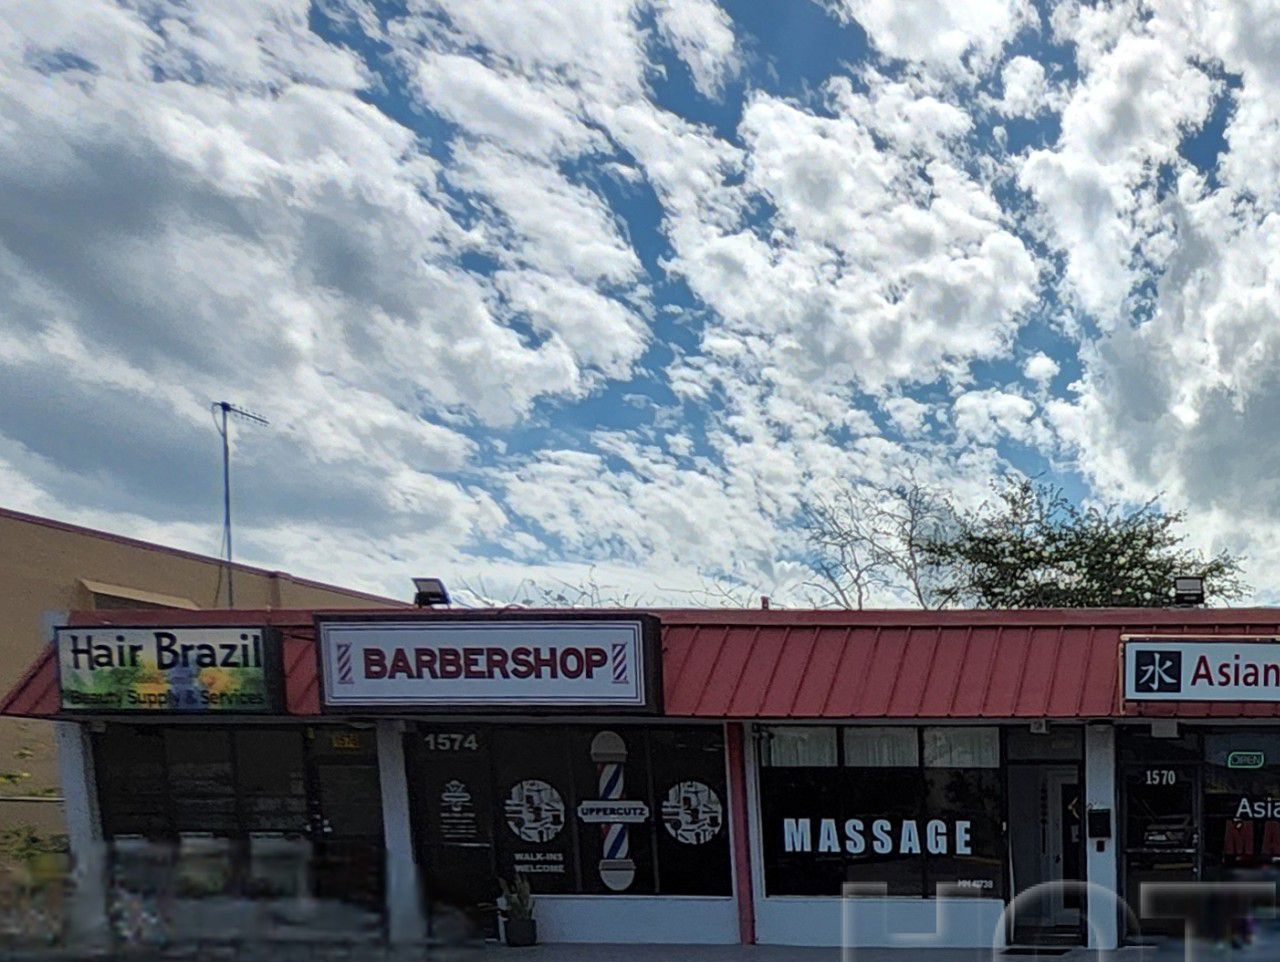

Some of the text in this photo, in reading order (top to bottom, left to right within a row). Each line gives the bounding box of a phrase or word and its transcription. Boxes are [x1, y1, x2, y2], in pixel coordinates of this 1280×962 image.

[70, 632, 263, 671] Hair Brazil
[363, 647, 608, 680] BARBERSHOP
[1138, 653, 1178, 690] 水
[1190, 654, 1280, 688] Asian
[127, 689, 180, 708] Supply
[201, 690, 265, 705] Services
[424, 733, 479, 751] 1574
[1232, 755, 1261, 765] OPEN
[1145, 771, 1176, 785] 1570
[581, 807, 646, 816] UPPERCUTZ
[784, 818, 972, 855] MASSAGE
[513, 852, 564, 861] WALK-INS
[514, 864, 565, 873] WELCOME
